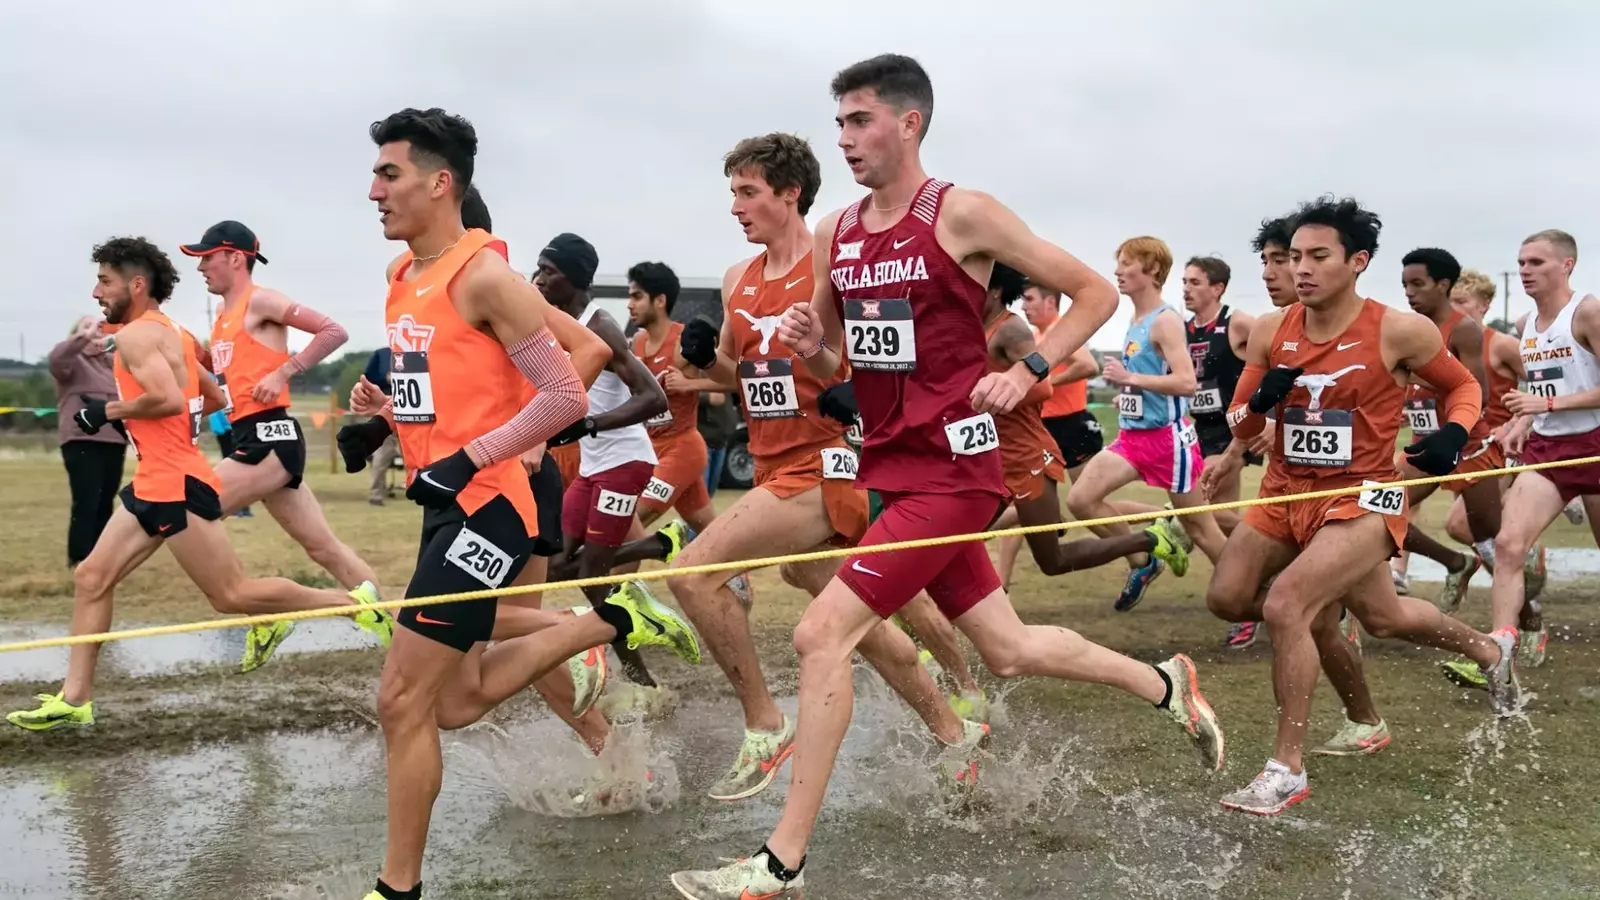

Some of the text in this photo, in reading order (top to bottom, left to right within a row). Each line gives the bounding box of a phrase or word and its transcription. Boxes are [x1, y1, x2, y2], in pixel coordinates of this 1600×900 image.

[831, 256, 929, 291] OKLAHOMA
[851, 326, 900, 357] 239
[1521, 346, 1572, 363] OWA TATE
[748, 381, 786, 406] 268
[1193, 393, 1214, 408] 286
[1121, 397, 1136, 412] 228
[1411, 412, 1432, 428] 261
[264, 424, 290, 438] 248
[960, 422, 996, 450] 239
[1292, 429, 1338, 454] 263
[832, 453, 857, 474] 268
[646, 481, 669, 499] 260
[1369, 488, 1403, 510] 263
[604, 496, 632, 513] 211
[458, 541, 503, 580] 250
